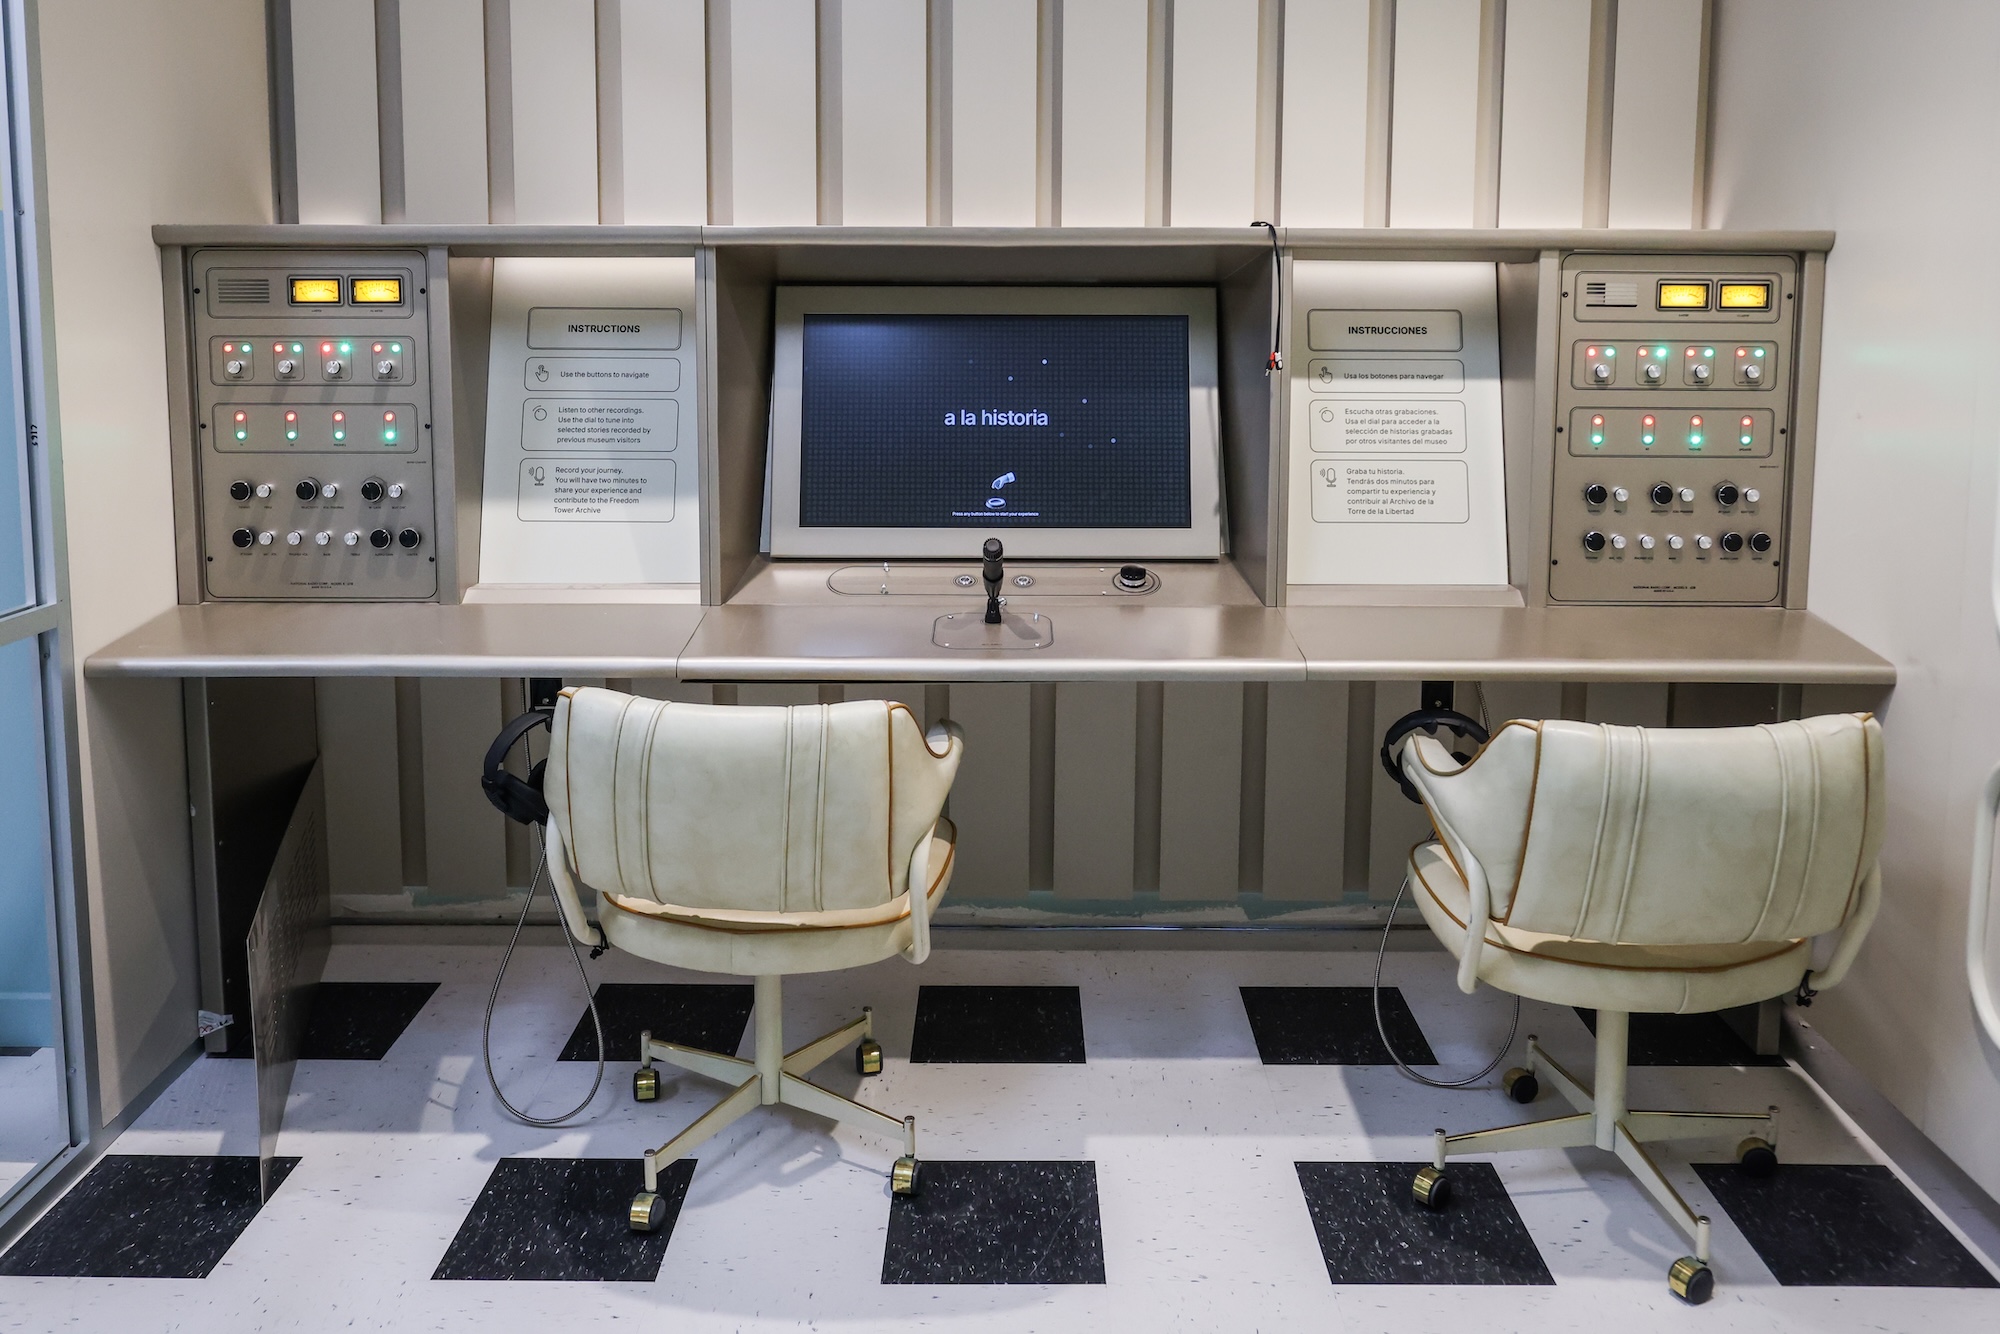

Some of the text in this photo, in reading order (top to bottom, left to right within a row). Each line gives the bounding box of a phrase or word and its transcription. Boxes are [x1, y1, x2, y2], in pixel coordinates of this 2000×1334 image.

[567, 324, 641, 332] INSTRUCTIONS
[1348, 326, 1428, 334] INSTRUCCIONES
[606, 407, 644, 415] recordings.
[1394, 408, 1439, 416] grabaciones.
[944, 408, 1049, 426] a la historia
[1420, 428, 1453, 436] grabadas
[596, 467, 624, 475] journey.
